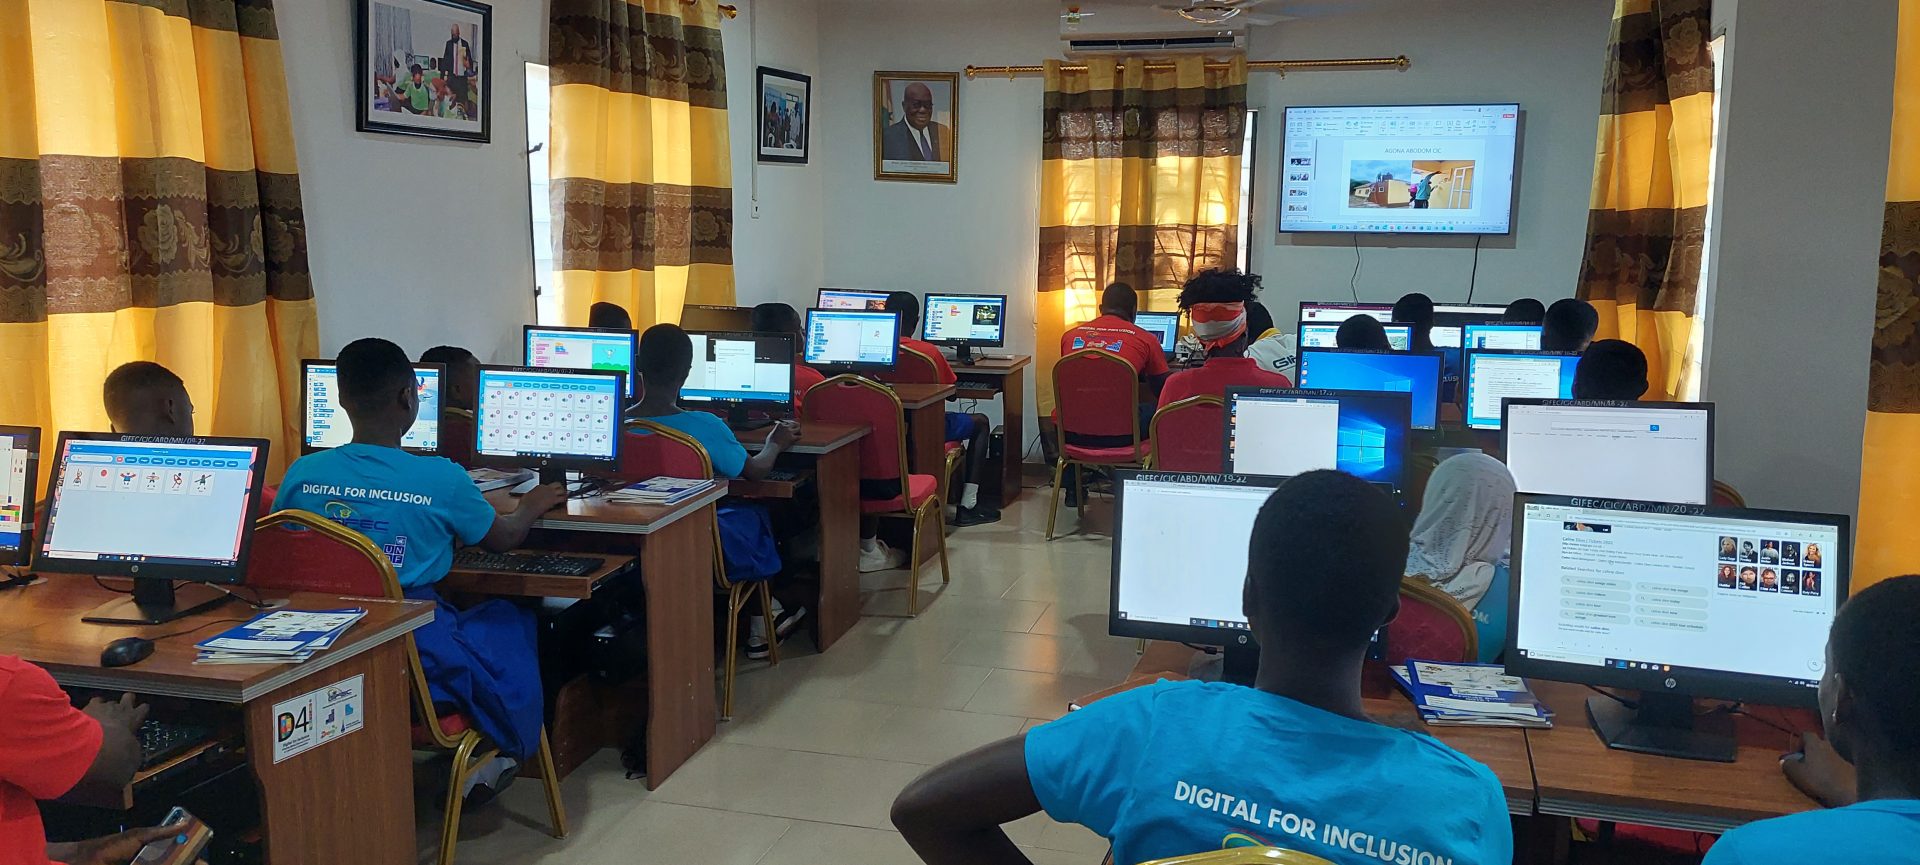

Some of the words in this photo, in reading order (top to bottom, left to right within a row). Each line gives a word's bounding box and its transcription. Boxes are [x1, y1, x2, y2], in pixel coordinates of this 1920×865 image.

[302, 484, 342, 496] DIGITAL
[344, 487, 366, 498] FOR
[368, 489, 432, 506] INCLUSION
[1174, 780, 1261, 824] DIGITAL
[1267, 808, 1316, 840] FOR
